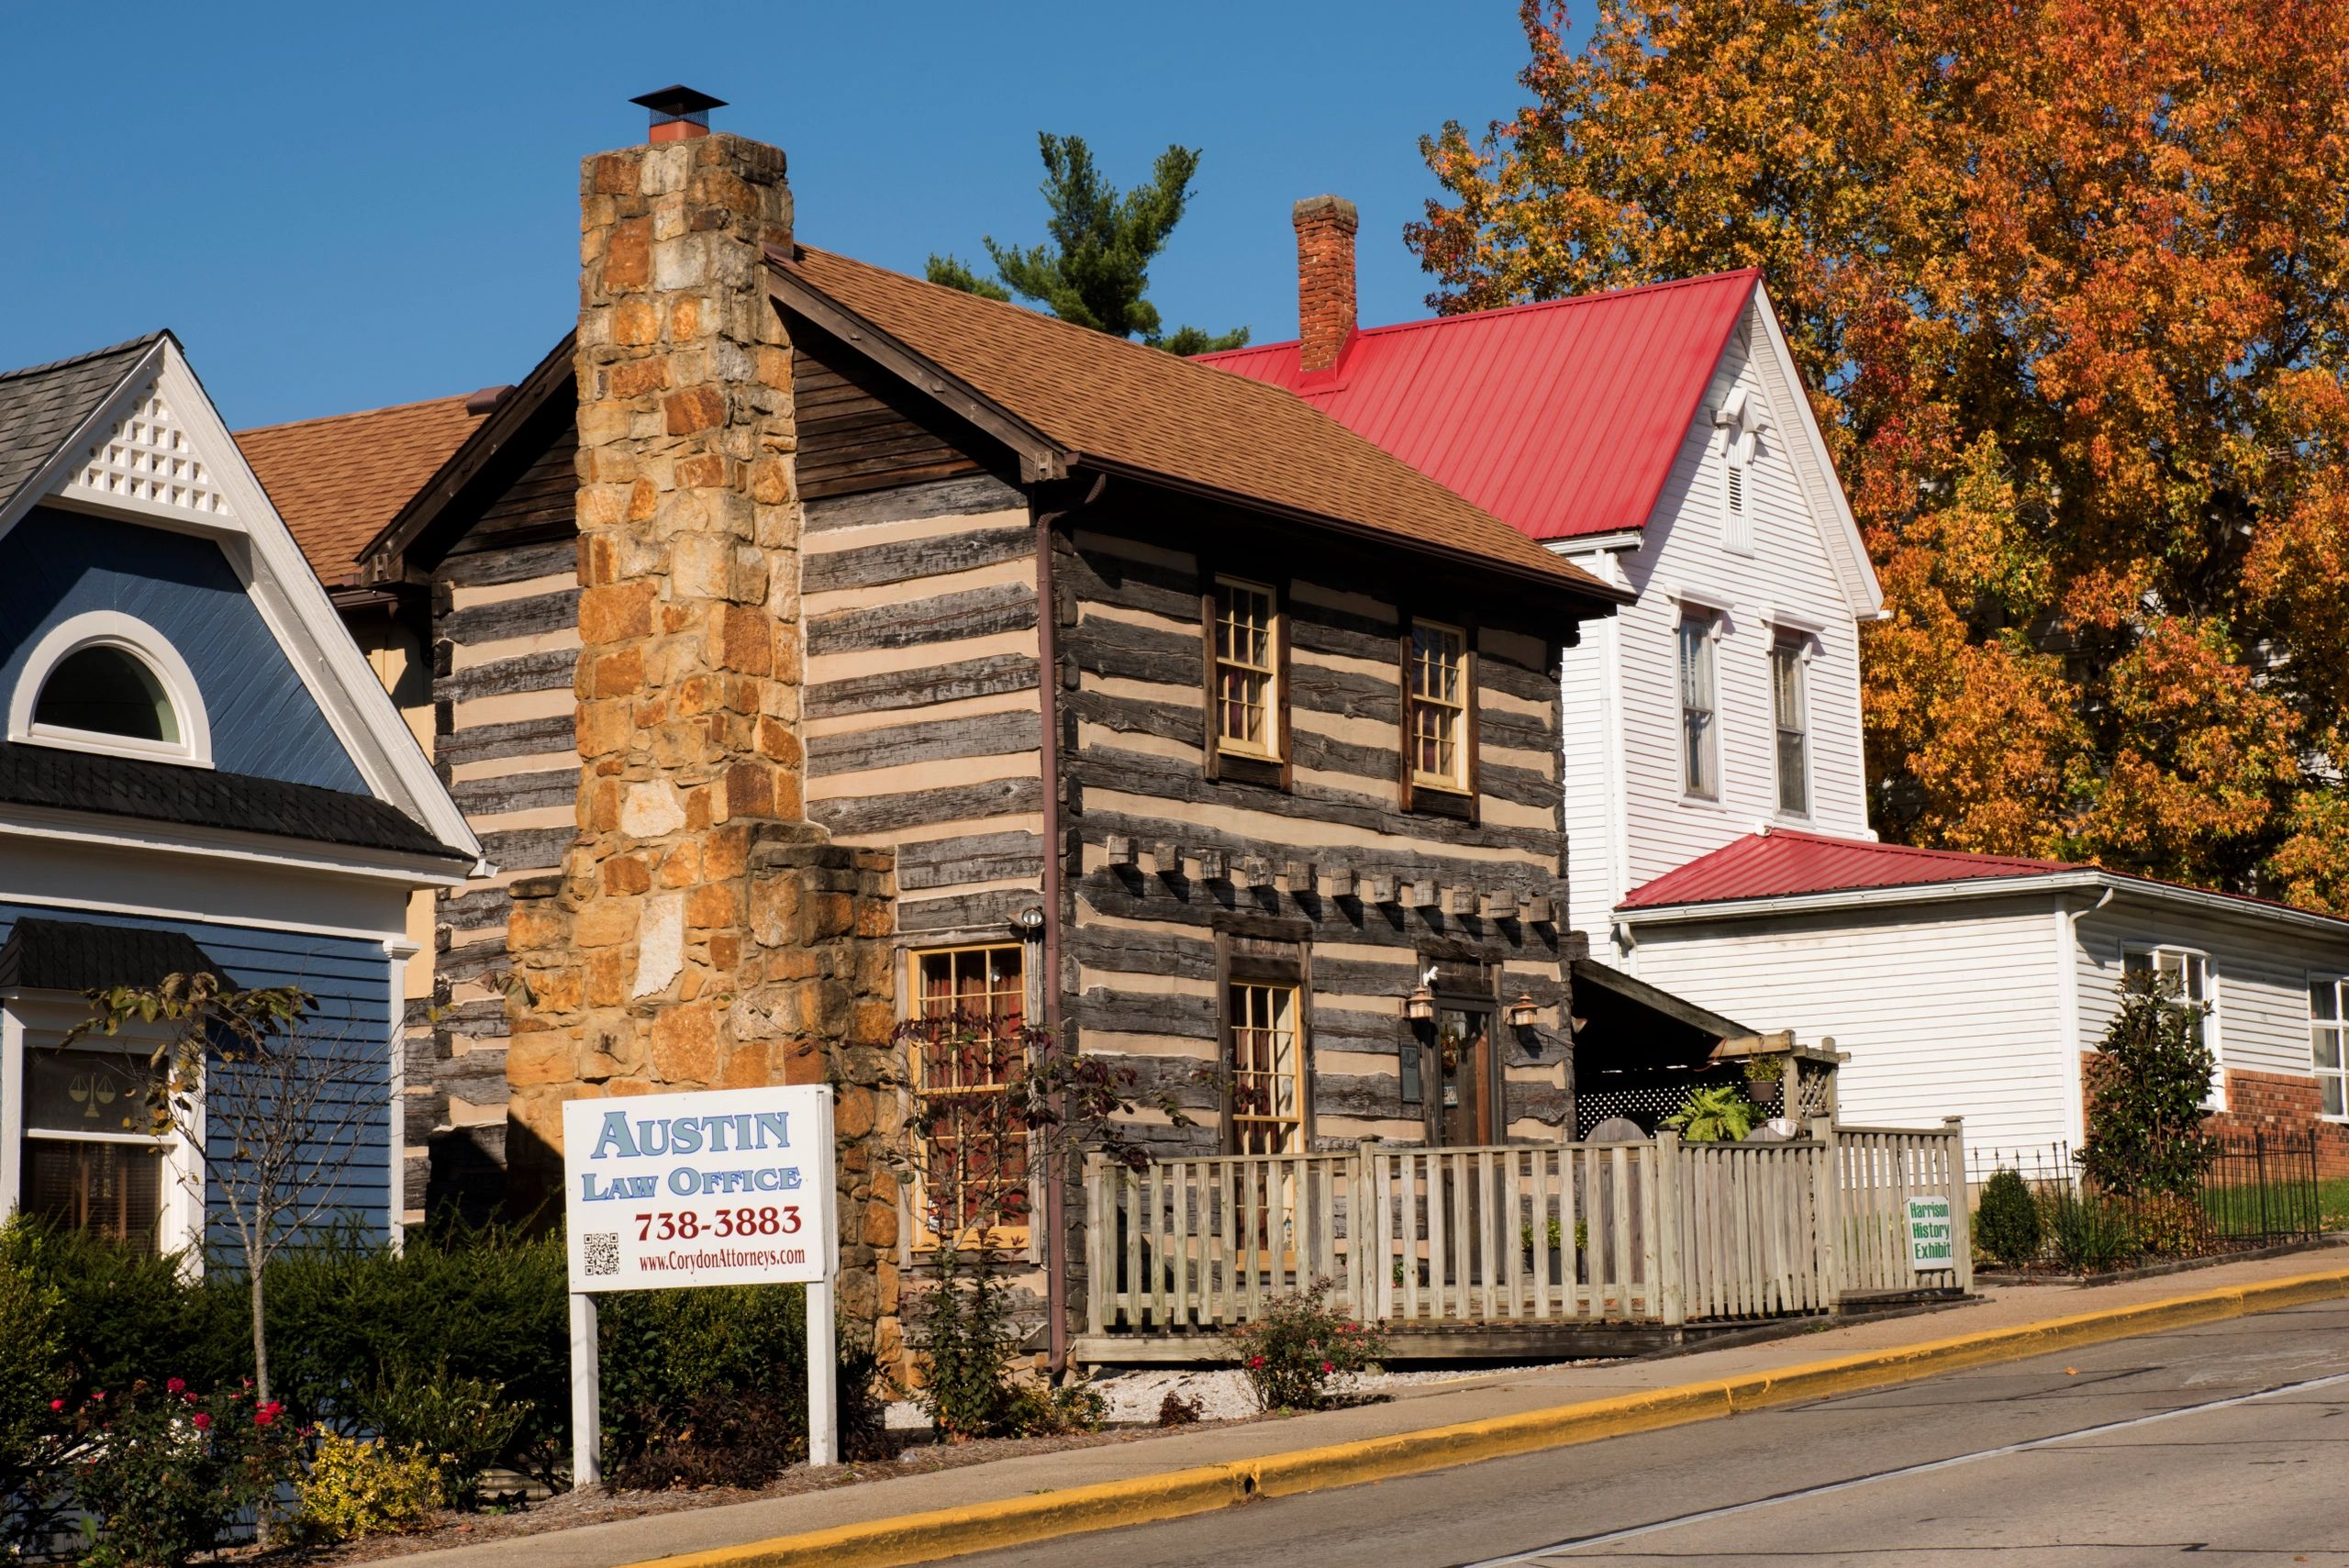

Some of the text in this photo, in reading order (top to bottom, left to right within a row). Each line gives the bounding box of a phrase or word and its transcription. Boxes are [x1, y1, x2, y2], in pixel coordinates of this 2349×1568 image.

[590, 1111, 790, 1159] AUSTIN
[582, 1167, 802, 1201] LAW OFFICE
[635, 1206, 802, 1241] 738-3883
[1909, 1202, 1949, 1218] Harrison
[1912, 1222, 1950, 1240] History
[640, 1247, 806, 1274] www.CorydonAttorneys.com
[1914, 1242, 1952, 1260] Exhibit
